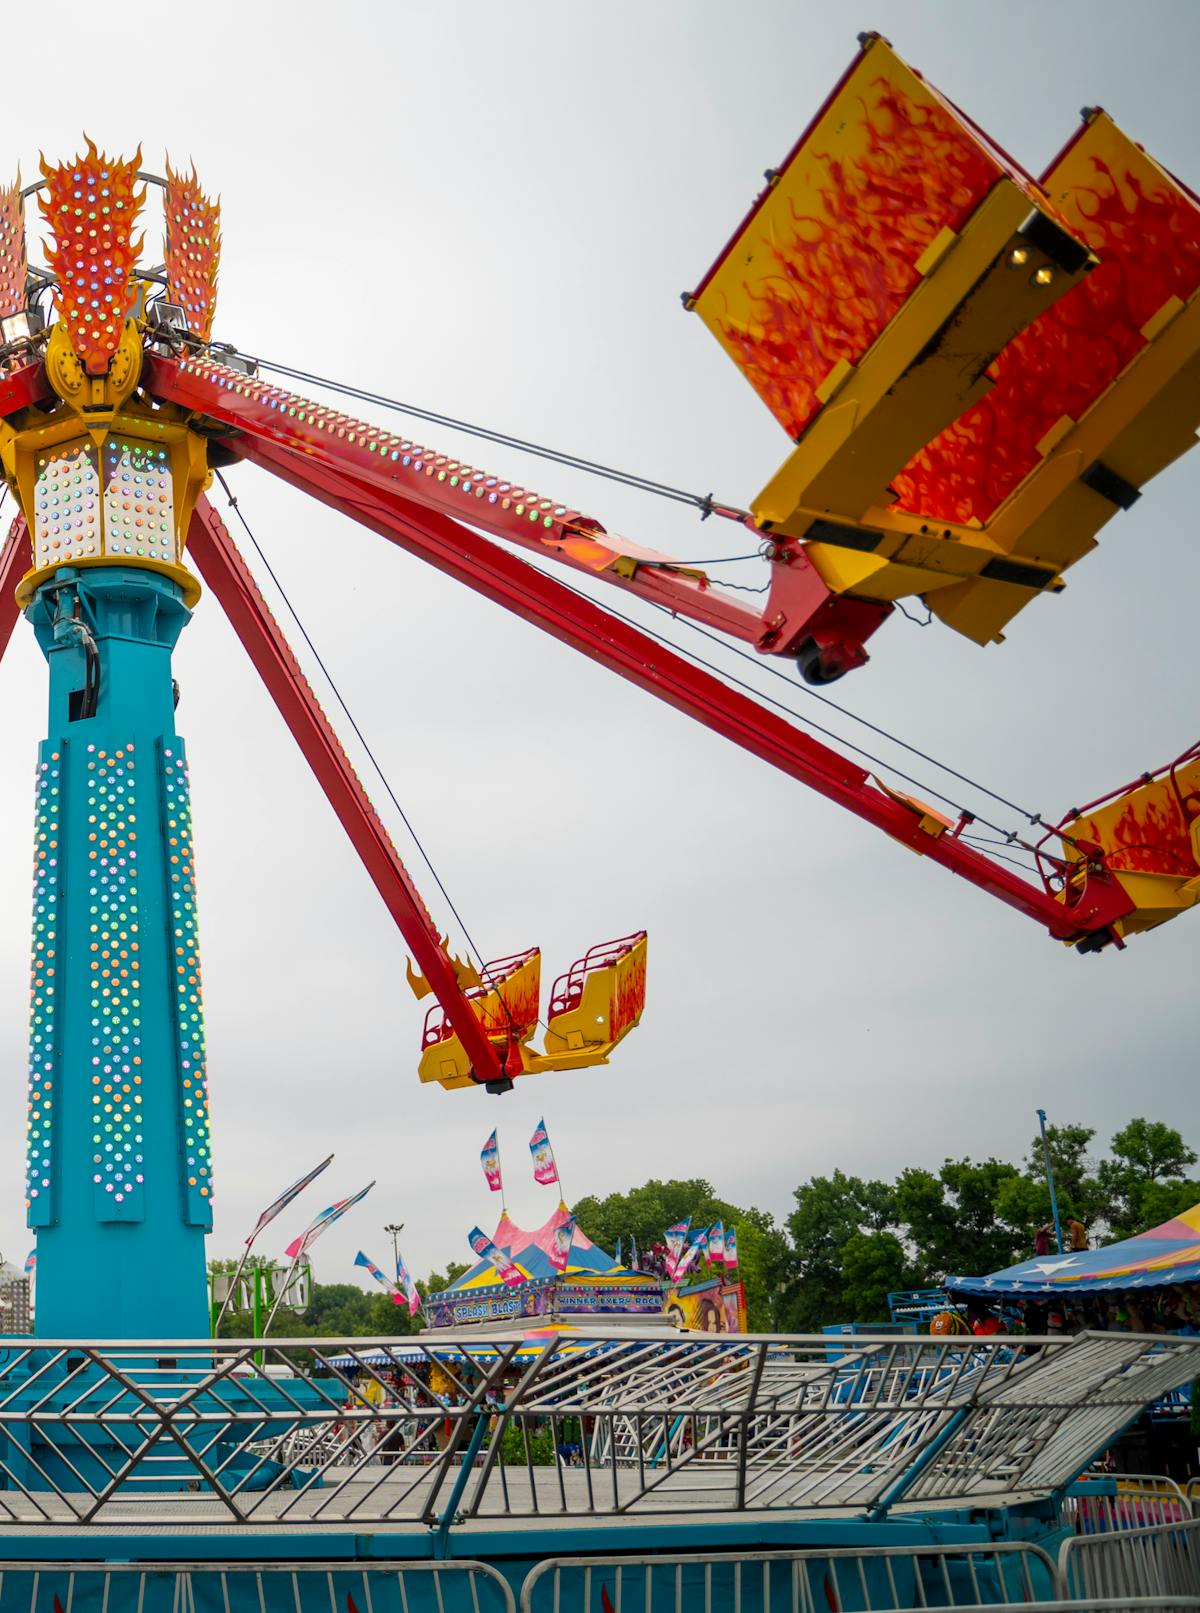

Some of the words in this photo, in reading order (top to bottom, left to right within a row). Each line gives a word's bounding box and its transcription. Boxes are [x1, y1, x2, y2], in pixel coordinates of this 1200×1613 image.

[600, 1297, 631, 1305] EVERY
[635, 1297, 661, 1305] RACE
[455, 1303, 489, 1319] SPLASH
[491, 1300, 520, 1315] BLAST
